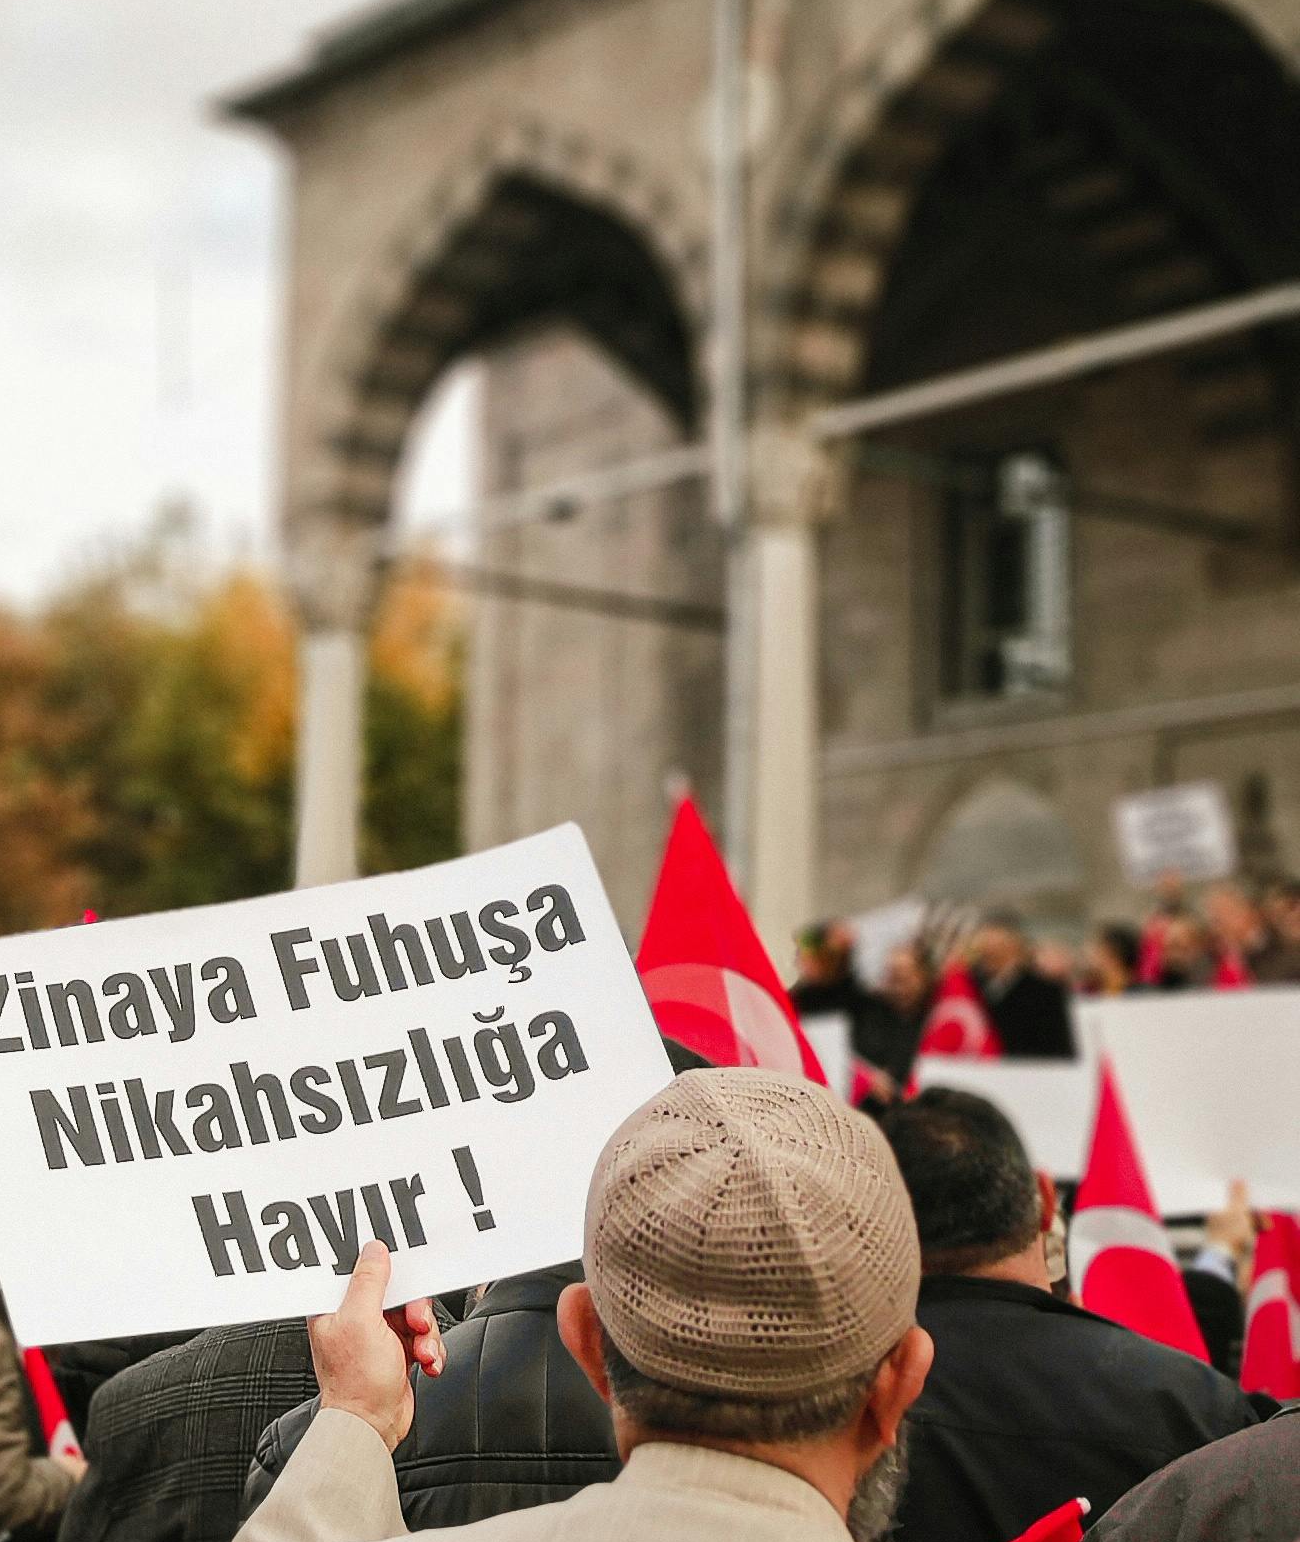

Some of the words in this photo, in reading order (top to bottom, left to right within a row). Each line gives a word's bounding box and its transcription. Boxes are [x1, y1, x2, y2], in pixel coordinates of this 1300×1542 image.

[270, 883, 587, 1012] Fuhuşa
[28, 1005, 591, 1171] Nikahsızlığa
[191, 1172, 428, 1277] Hayır
[450, 1144, 497, 1233] !
